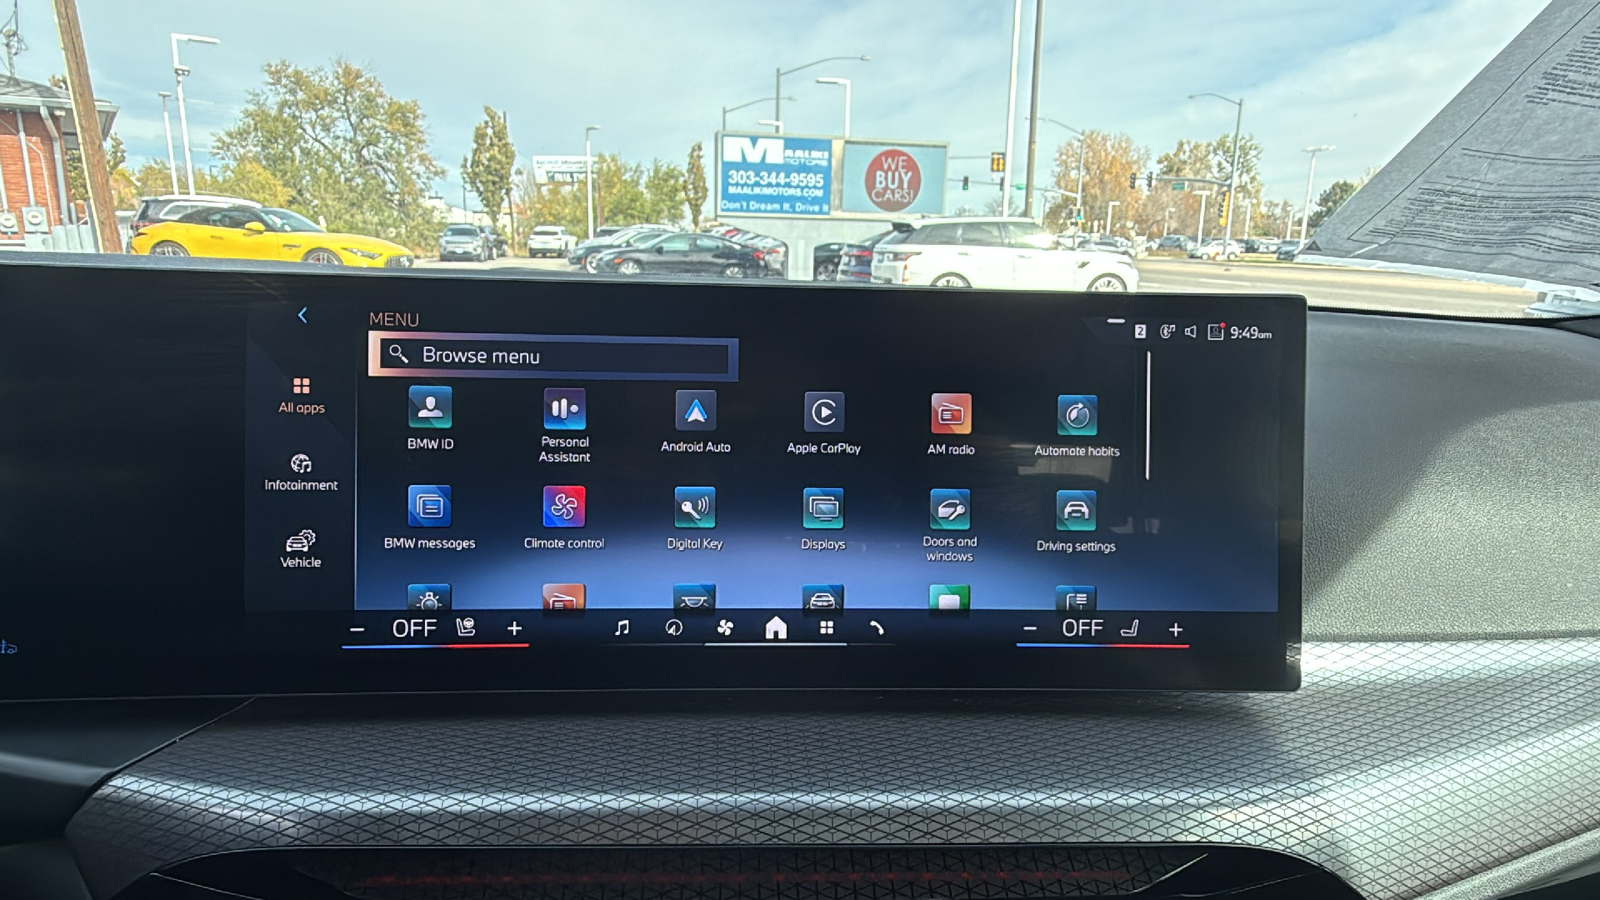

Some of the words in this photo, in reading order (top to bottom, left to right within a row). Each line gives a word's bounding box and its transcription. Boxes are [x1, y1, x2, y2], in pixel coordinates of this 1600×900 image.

[881, 156, 908, 171] WE
[728, 170, 824, 187] 303-344-9595
[875, 170, 912, 190] BUY
[728, 186, 824, 197] MAALIKIMOTORS.COM
[871, 189, 914, 203] CARS!
[722, 200, 748, 210] Don't
[749, 201, 781, 211] Dream
[795, 203, 820, 212] Drive
[822, 204, 829, 212] It
[369, 311, 420, 328] MENU
[422, 346, 488, 364] Browse
[492, 350, 540, 365] menu
[278, 401, 294, 413] All
[296, 404, 326, 416] apps
[407, 437, 438, 450] BMW
[441, 438, 455, 450] ID
[541, 435, 590, 448] Personal
[660, 440, 703, 454] Android
[705, 441, 731, 454] Auto
[786, 442, 818, 456] Apple
[820, 442, 862, 456] CarPlay
[927, 443, 946, 455] AM
[948, 444, 976, 455] radio
[1034, 445, 1085, 458] Automate
[1087, 446, 1121, 458] habits
[538, 451, 591, 463] Assistant
[264, 479, 339, 491] Infotainment
[384, 537, 416, 549] BMW
[417, 539, 476, 552] messages
[523, 537, 566, 549] Climate
[567, 537, 605, 549] control
[667, 537, 701, 551] Digital
[703, 537, 724, 552] Key
[801, 538, 846, 551] Displays
[922, 535, 955, 548] Doors
[956, 536, 978, 548] and
[1036, 541, 1073, 554] Driving
[1074, 541, 1117, 555] settings
[279, 556, 322, 569] Vehicle
[926, 550, 974, 563] windows
[392, 618, 438, 638] OFF
[1062, 618, 1104, 637] OFF
